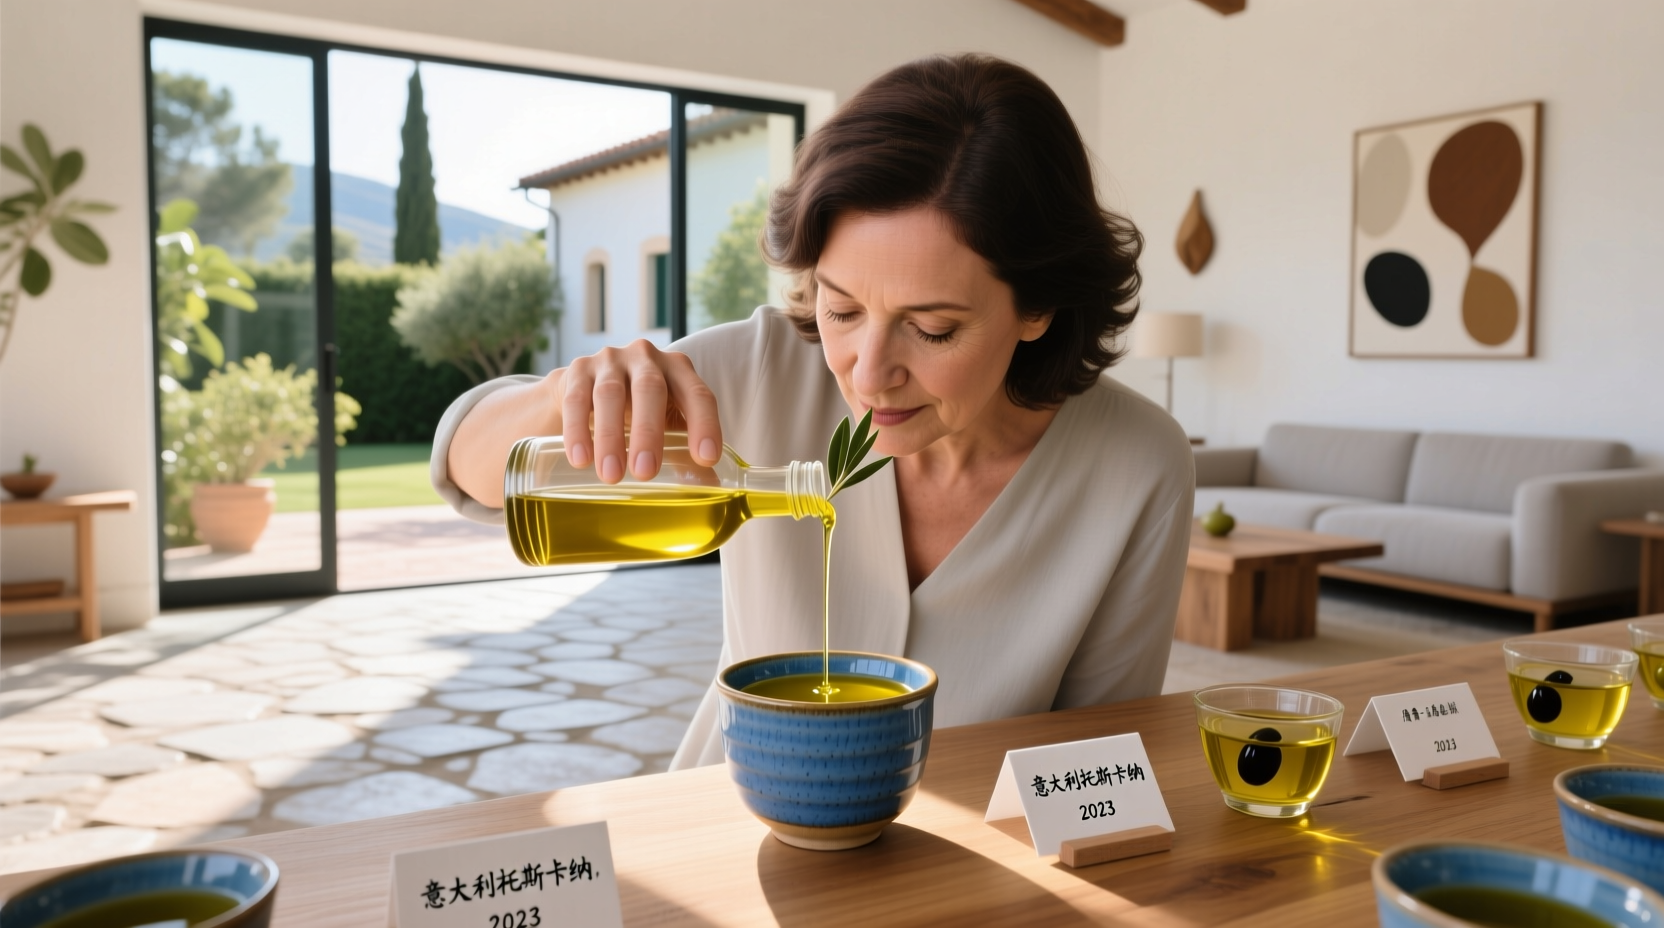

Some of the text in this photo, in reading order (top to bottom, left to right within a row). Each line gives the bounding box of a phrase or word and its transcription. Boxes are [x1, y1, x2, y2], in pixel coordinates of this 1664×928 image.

[1031, 763, 1145, 797] 意大利托斯卡纳
[1079, 800, 1116, 820] 2023
[489, 906, 541, 928] 2023
